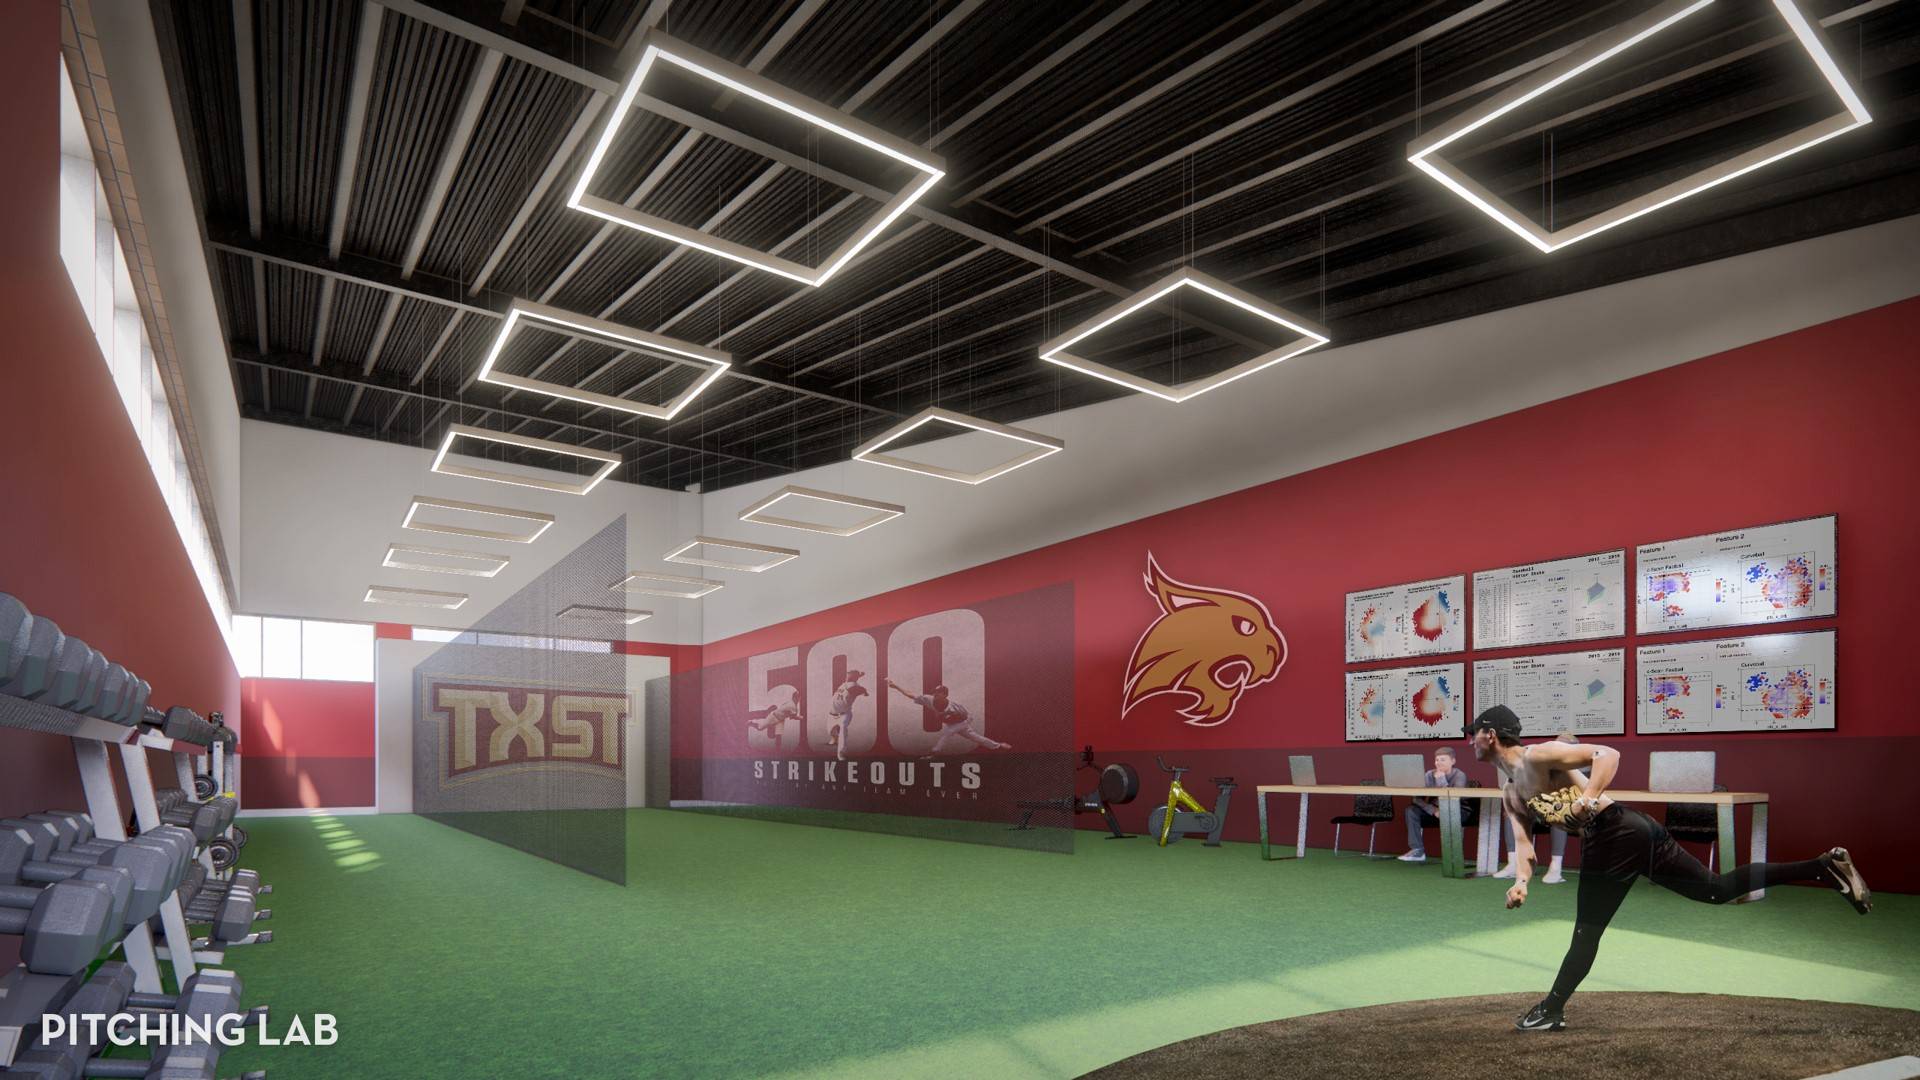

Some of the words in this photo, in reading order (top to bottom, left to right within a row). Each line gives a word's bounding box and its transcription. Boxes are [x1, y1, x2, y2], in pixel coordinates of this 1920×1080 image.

[1715, 535, 1739, 543] Feature
[1639, 546, 1661, 555] Feature
[748, 608, 985, 756] 500
[437, 687, 629, 771] TXST
[754, 760, 982, 790] STRIKEOUTS
[863, 786, 906, 796] TEAM
[926, 789, 978, 801] EVER
